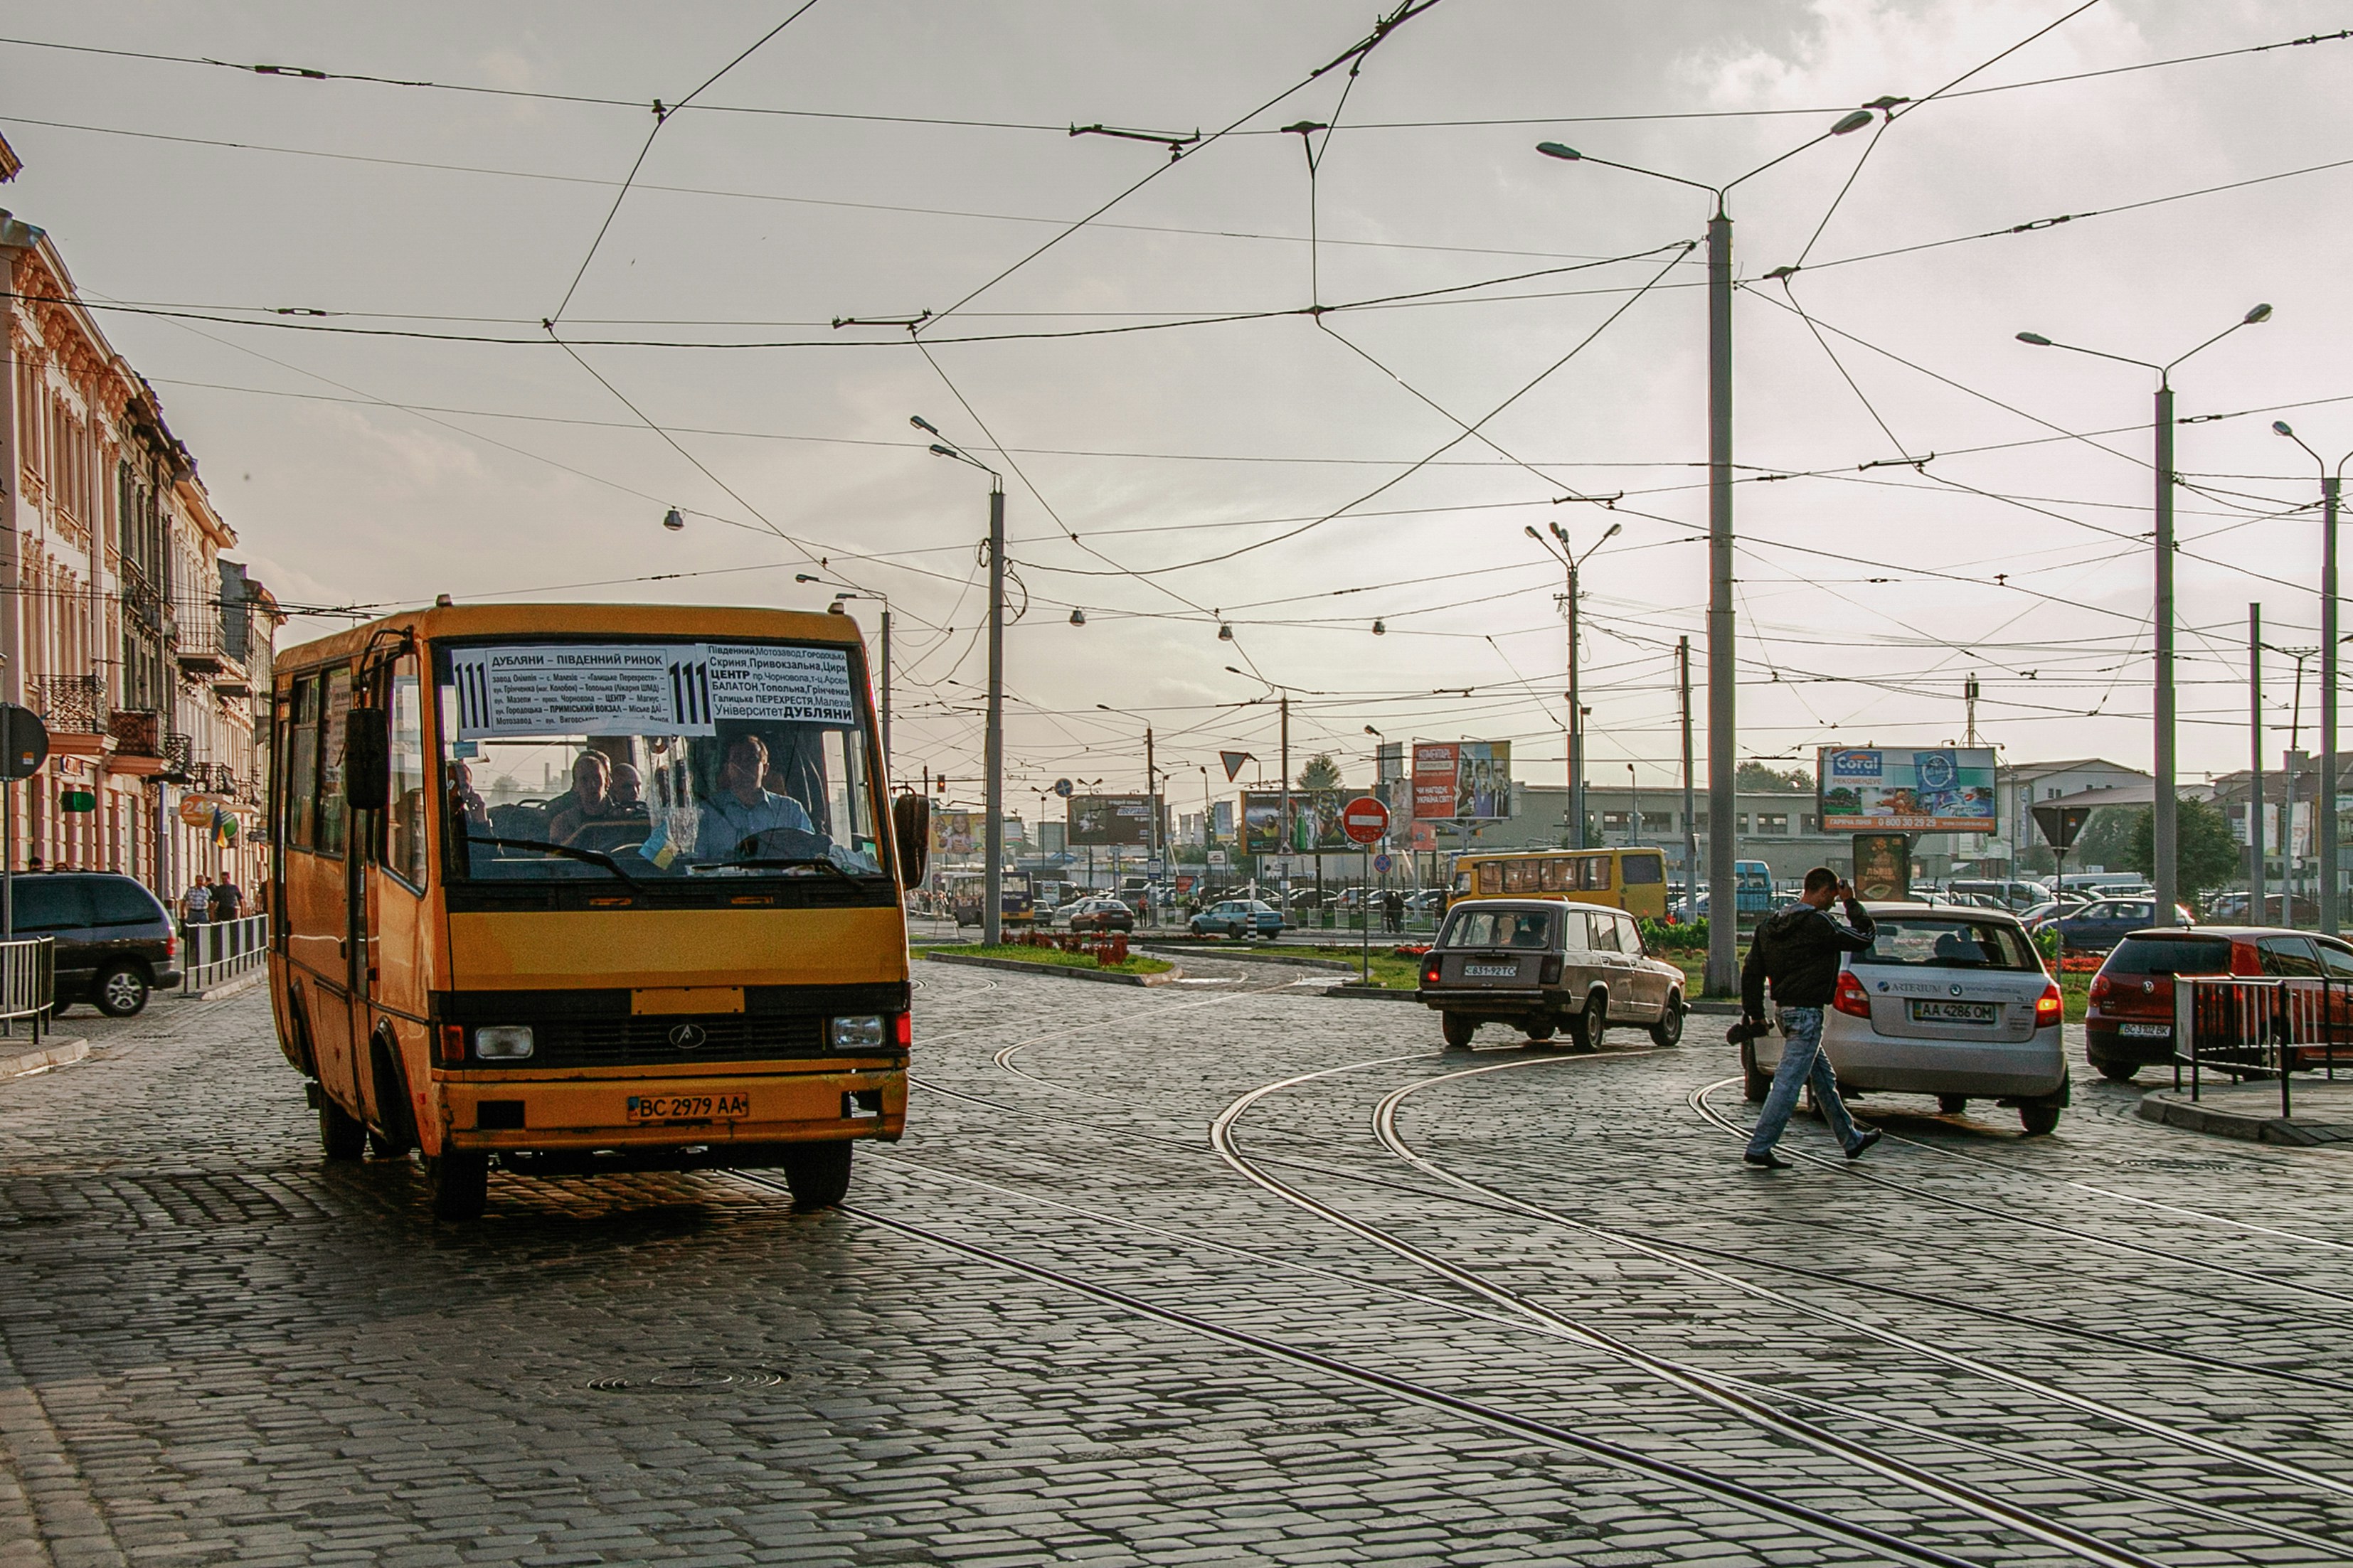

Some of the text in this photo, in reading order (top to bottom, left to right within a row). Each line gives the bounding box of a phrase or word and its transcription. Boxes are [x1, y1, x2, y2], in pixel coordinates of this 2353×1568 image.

[492, 653, 663, 667] ДУБЛЯНИ ПІВДЕННИЙ РИНОК
[711, 669, 750, 681] ЦЕНТР
[455, 662, 490, 729] 111
[561, 694, 595, 703] Чорновола
[605, 694, 627, 703] ЦЕНТР
[669, 661, 711, 724] 111
[506, 706, 543, 715] Городоцька
[550, 703, 595, 713] ПРИМІСЬКИЙ
[784, 706, 852, 720] ДУБЛЯНИ
[496, 717, 532, 725] Мотозавод
[1837, 756, 1878, 769] Coral
[1878, 818, 1884, 826] 0
[1886, 818, 1901, 826] 800
[1903, 818, 1913, 826] 30
[1914, 818, 1925, 827] 29
[1926, 818, 1937, 827] 29
[1891, 983, 1941, 993] ARTERIUM
[1923, 1005, 1991, 1018] AA 4286 OM
[2124, 1025, 2167, 1035] BC 3102 BK
[641, 1097, 742, 1116] BC 2979 AA
